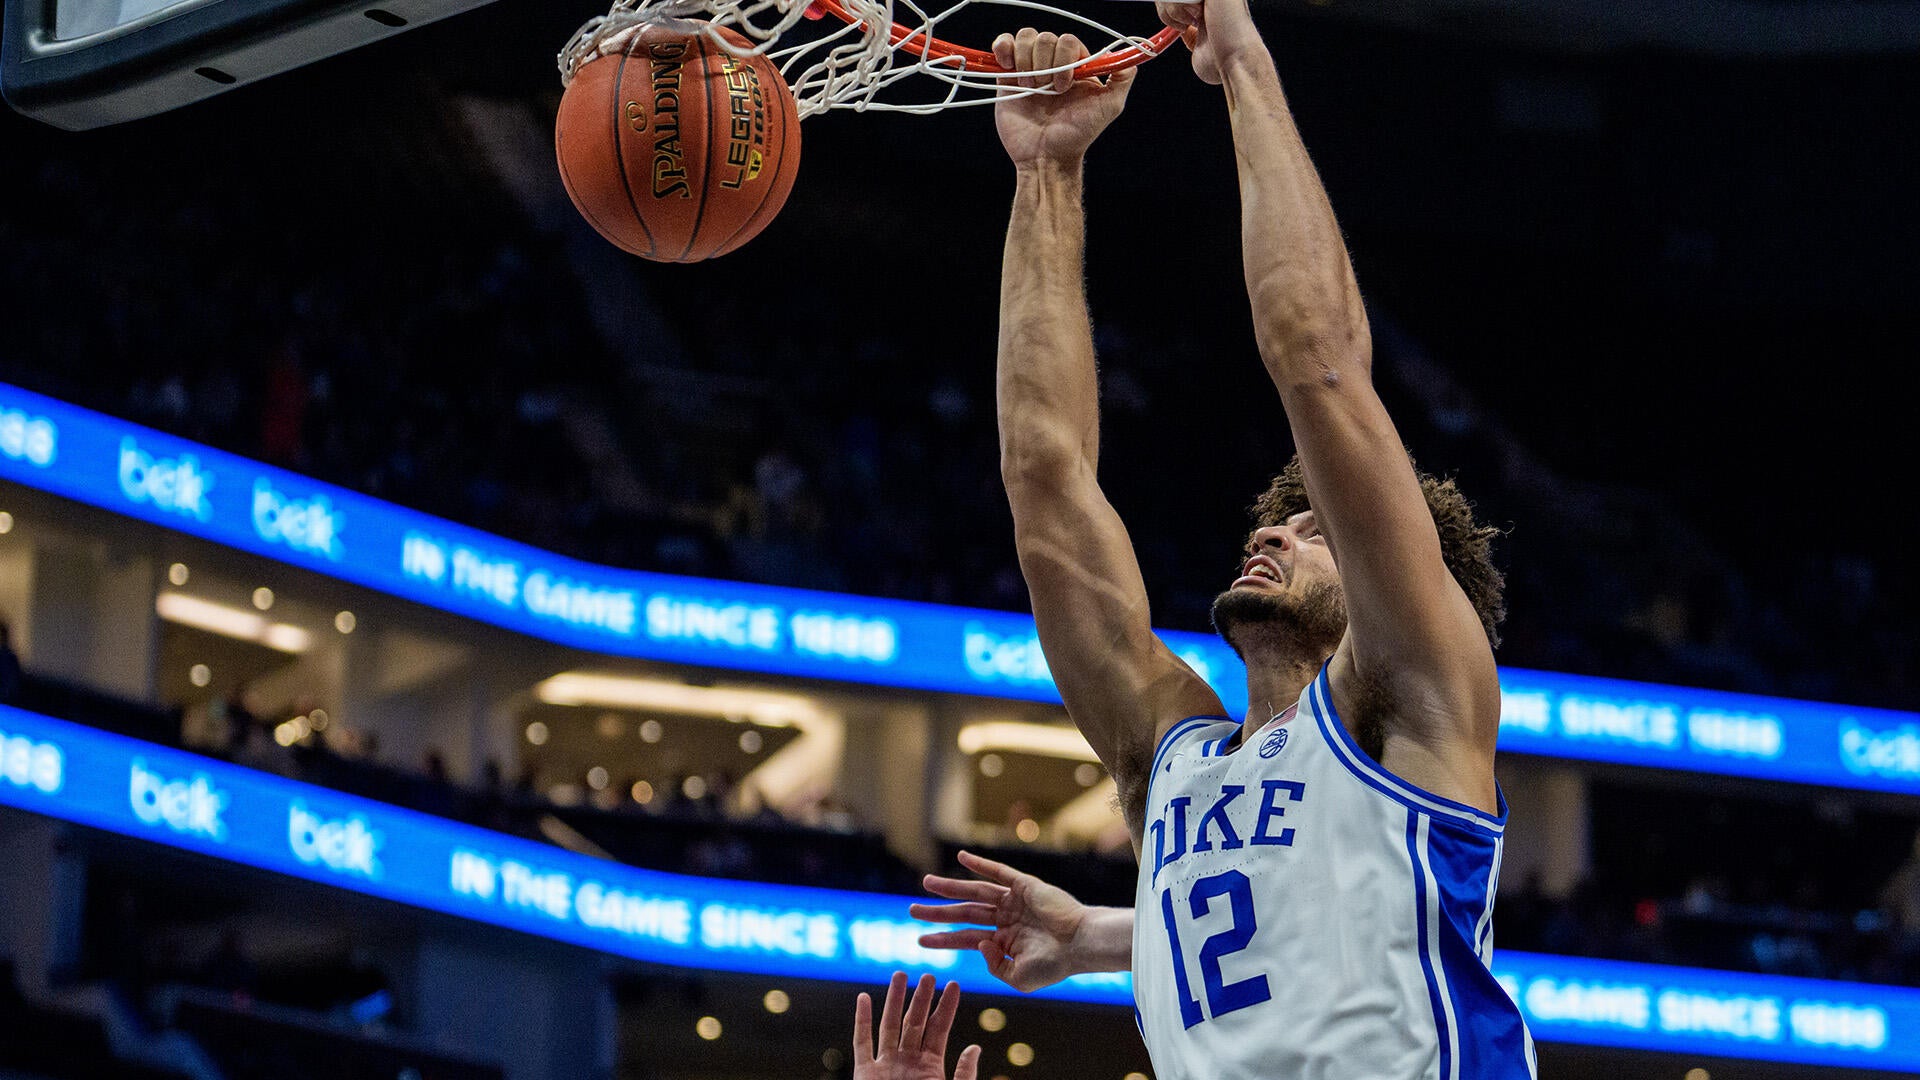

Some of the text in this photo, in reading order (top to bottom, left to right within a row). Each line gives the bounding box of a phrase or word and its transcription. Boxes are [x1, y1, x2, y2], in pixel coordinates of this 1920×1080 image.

[650, 40, 692, 200] SPALDING
[718, 51, 751, 190] LEGACY
[402, 534, 897, 662] IN THE GAME SINCE 1888
[1558, 695, 1679, 748] SINCE
[1687, 710, 1783, 758] 1888
[450, 850, 497, 900] IN
[499, 860, 573, 920] THE
[574, 881, 692, 946] GAME
[699, 902, 840, 960] SINCE
[1161, 868, 1272, 1031] 12
[1524, 977, 1650, 1029] GAME
[1656, 988, 1781, 1042] SINCE
[1788, 1002, 1887, 1051] 1888
